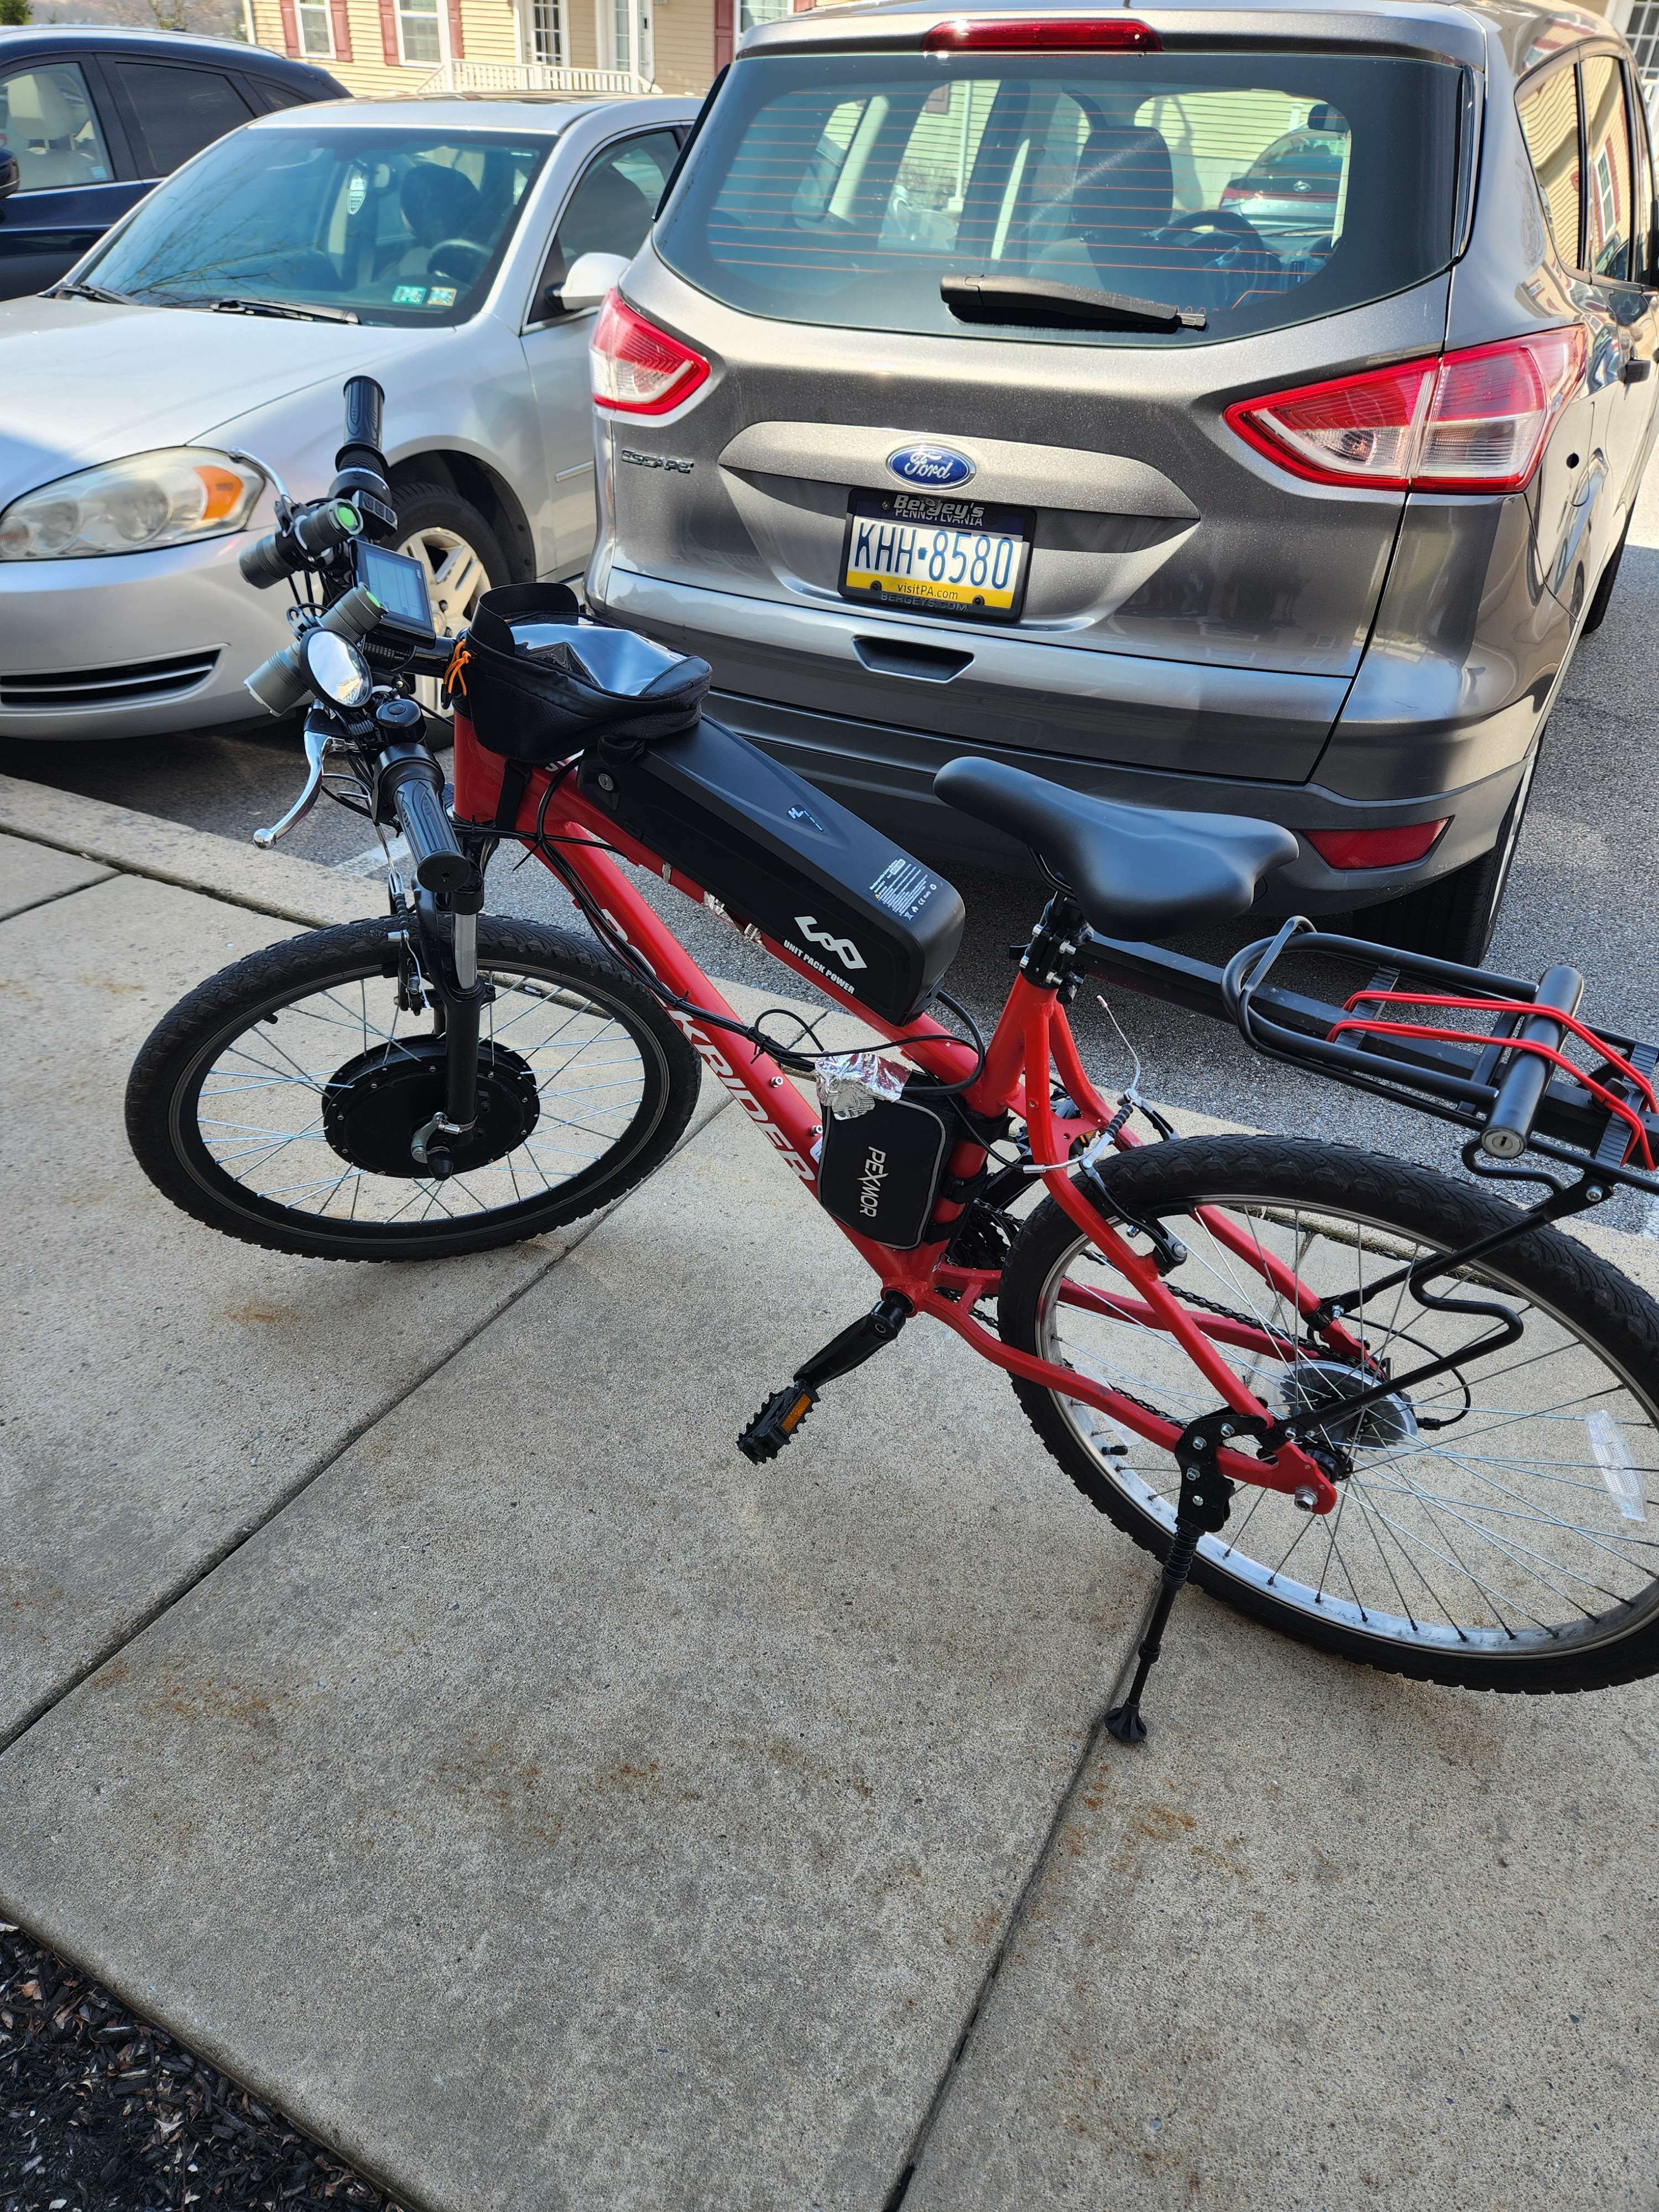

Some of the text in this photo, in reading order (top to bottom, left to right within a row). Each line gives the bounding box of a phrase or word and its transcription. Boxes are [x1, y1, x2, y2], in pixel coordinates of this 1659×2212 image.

[904, 451, 953, 479] Ford
[894, 495, 985, 519] Bergey's
[898, 582, 958, 600] visitPA.com
[784, 940, 855, 994] UNIT PACK POWER
[857, 1146, 889, 1217] PEXMOR
